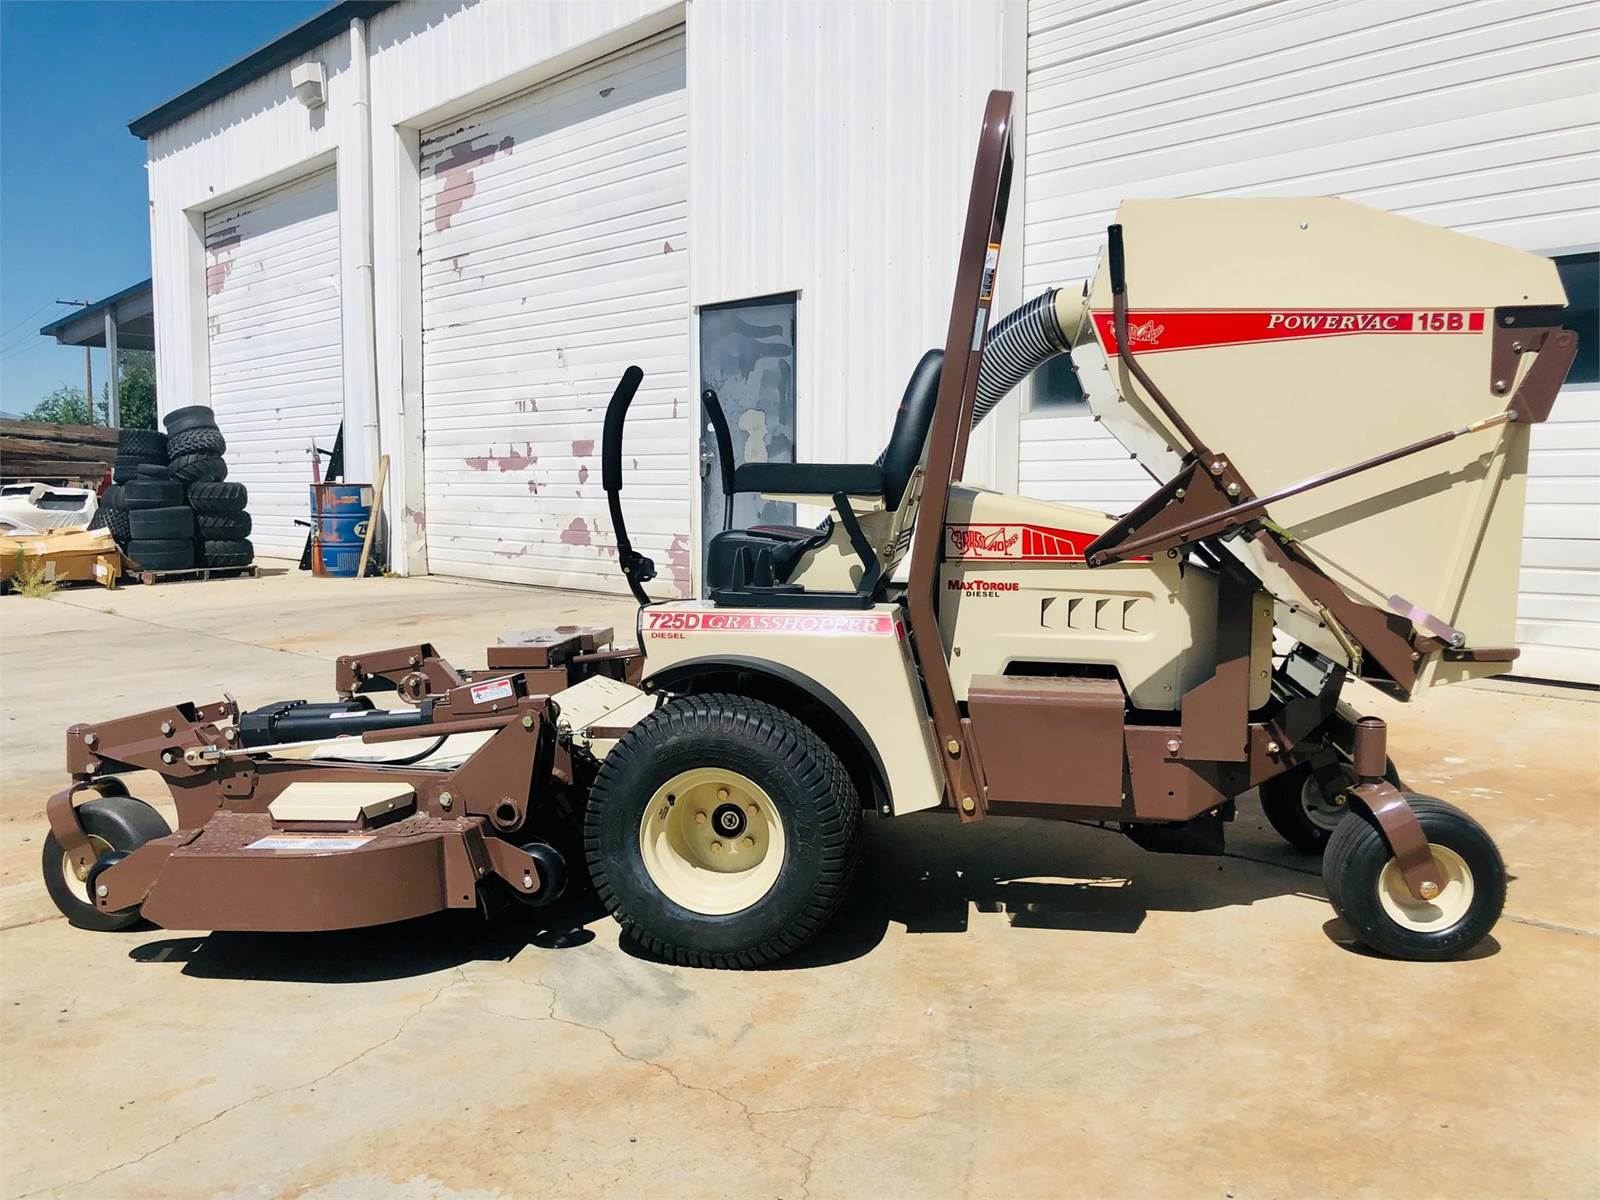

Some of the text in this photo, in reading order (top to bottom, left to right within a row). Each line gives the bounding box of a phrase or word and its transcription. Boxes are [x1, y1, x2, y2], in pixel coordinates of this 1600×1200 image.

[1266, 312, 1464, 331] POWERVAC 15B
[649, 613, 879, 633] 725D GRASSHOPPER
